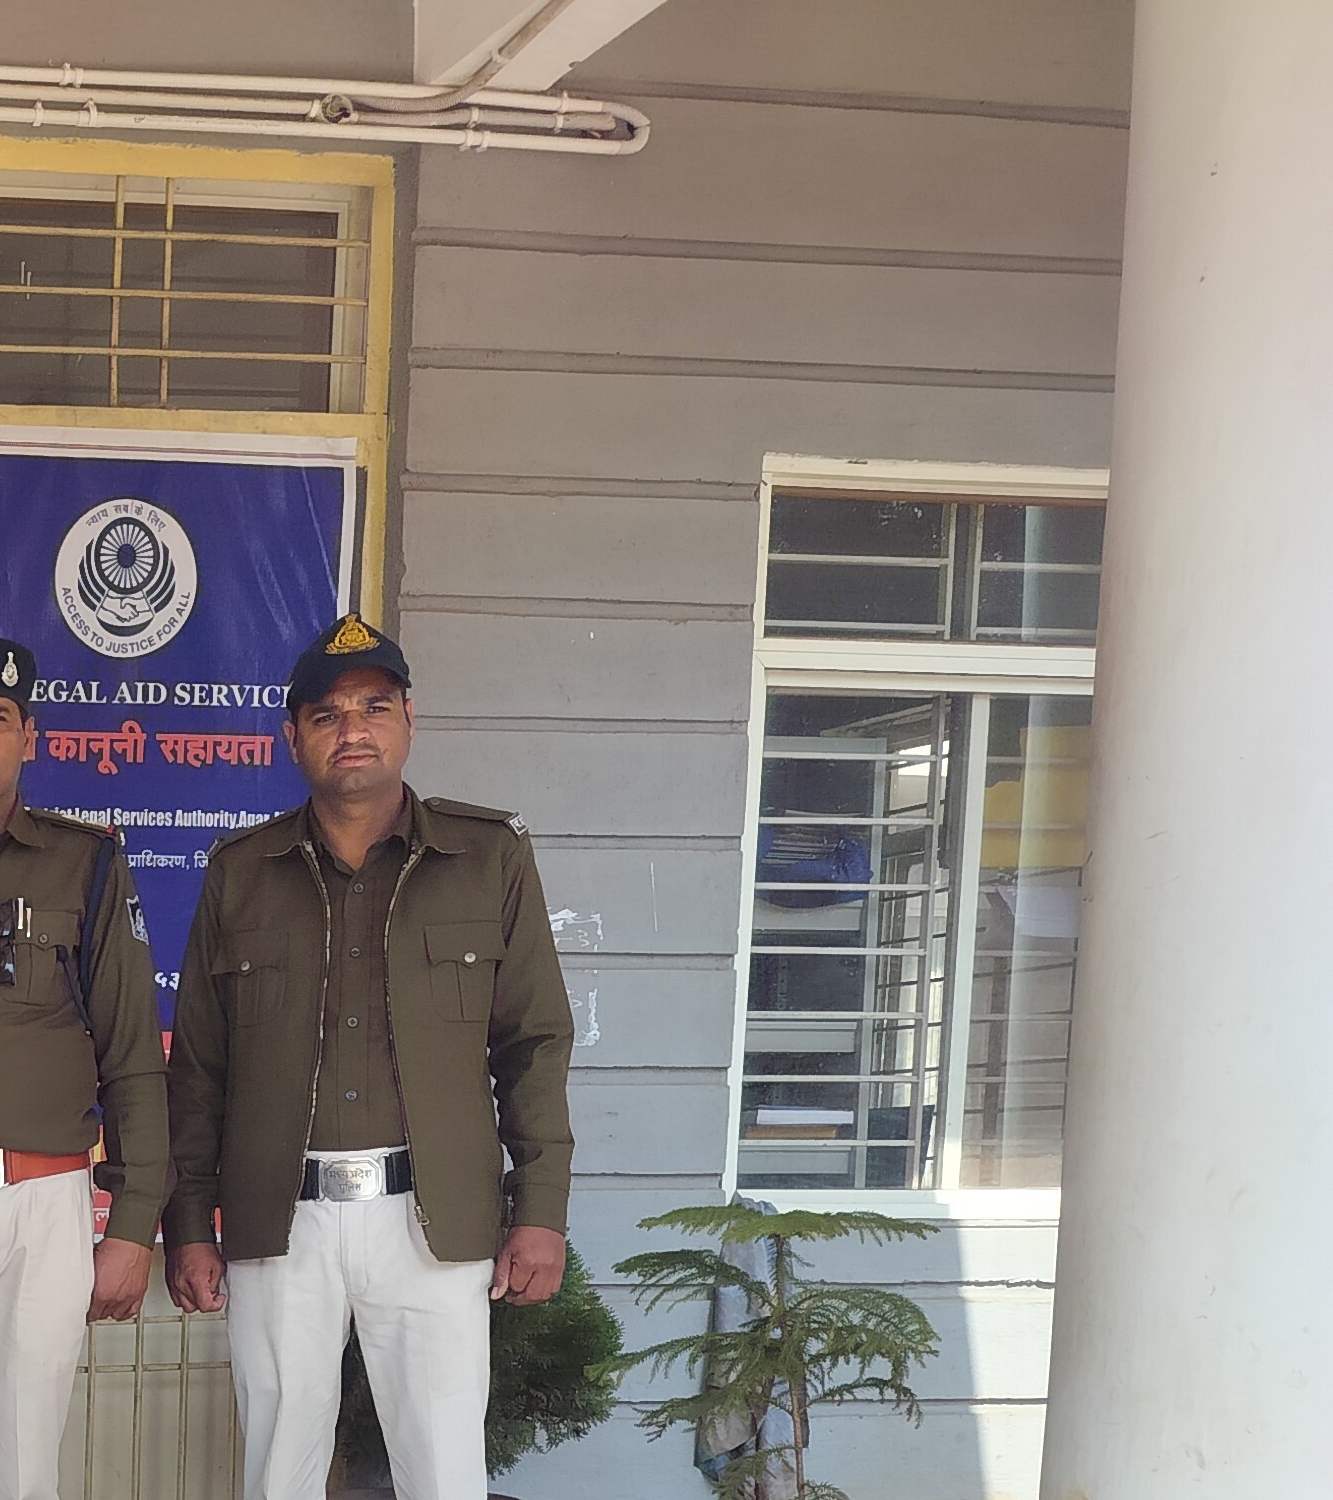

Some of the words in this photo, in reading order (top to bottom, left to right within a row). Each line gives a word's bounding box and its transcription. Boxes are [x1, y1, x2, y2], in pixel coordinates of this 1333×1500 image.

[85, 508, 109, 527] न्याय
[112, 504, 129, 515] सब
[134, 503, 144, 516] के
[146, 509, 167, 533] लिए
[61, 586, 91, 637] ACCESS
[90, 631, 104, 648] TO
[105, 635, 157, 654] JUSTICE
[156, 616, 179, 642] FOR
[175, 591, 191, 618] ALL
[30, 679, 107, 704] EGAL
[112, 681, 168, 706] AID
[45, 719, 148, 776] कानूनी
[155, 733, 275, 769] सहायता
[113, 808, 173, 827] Services
